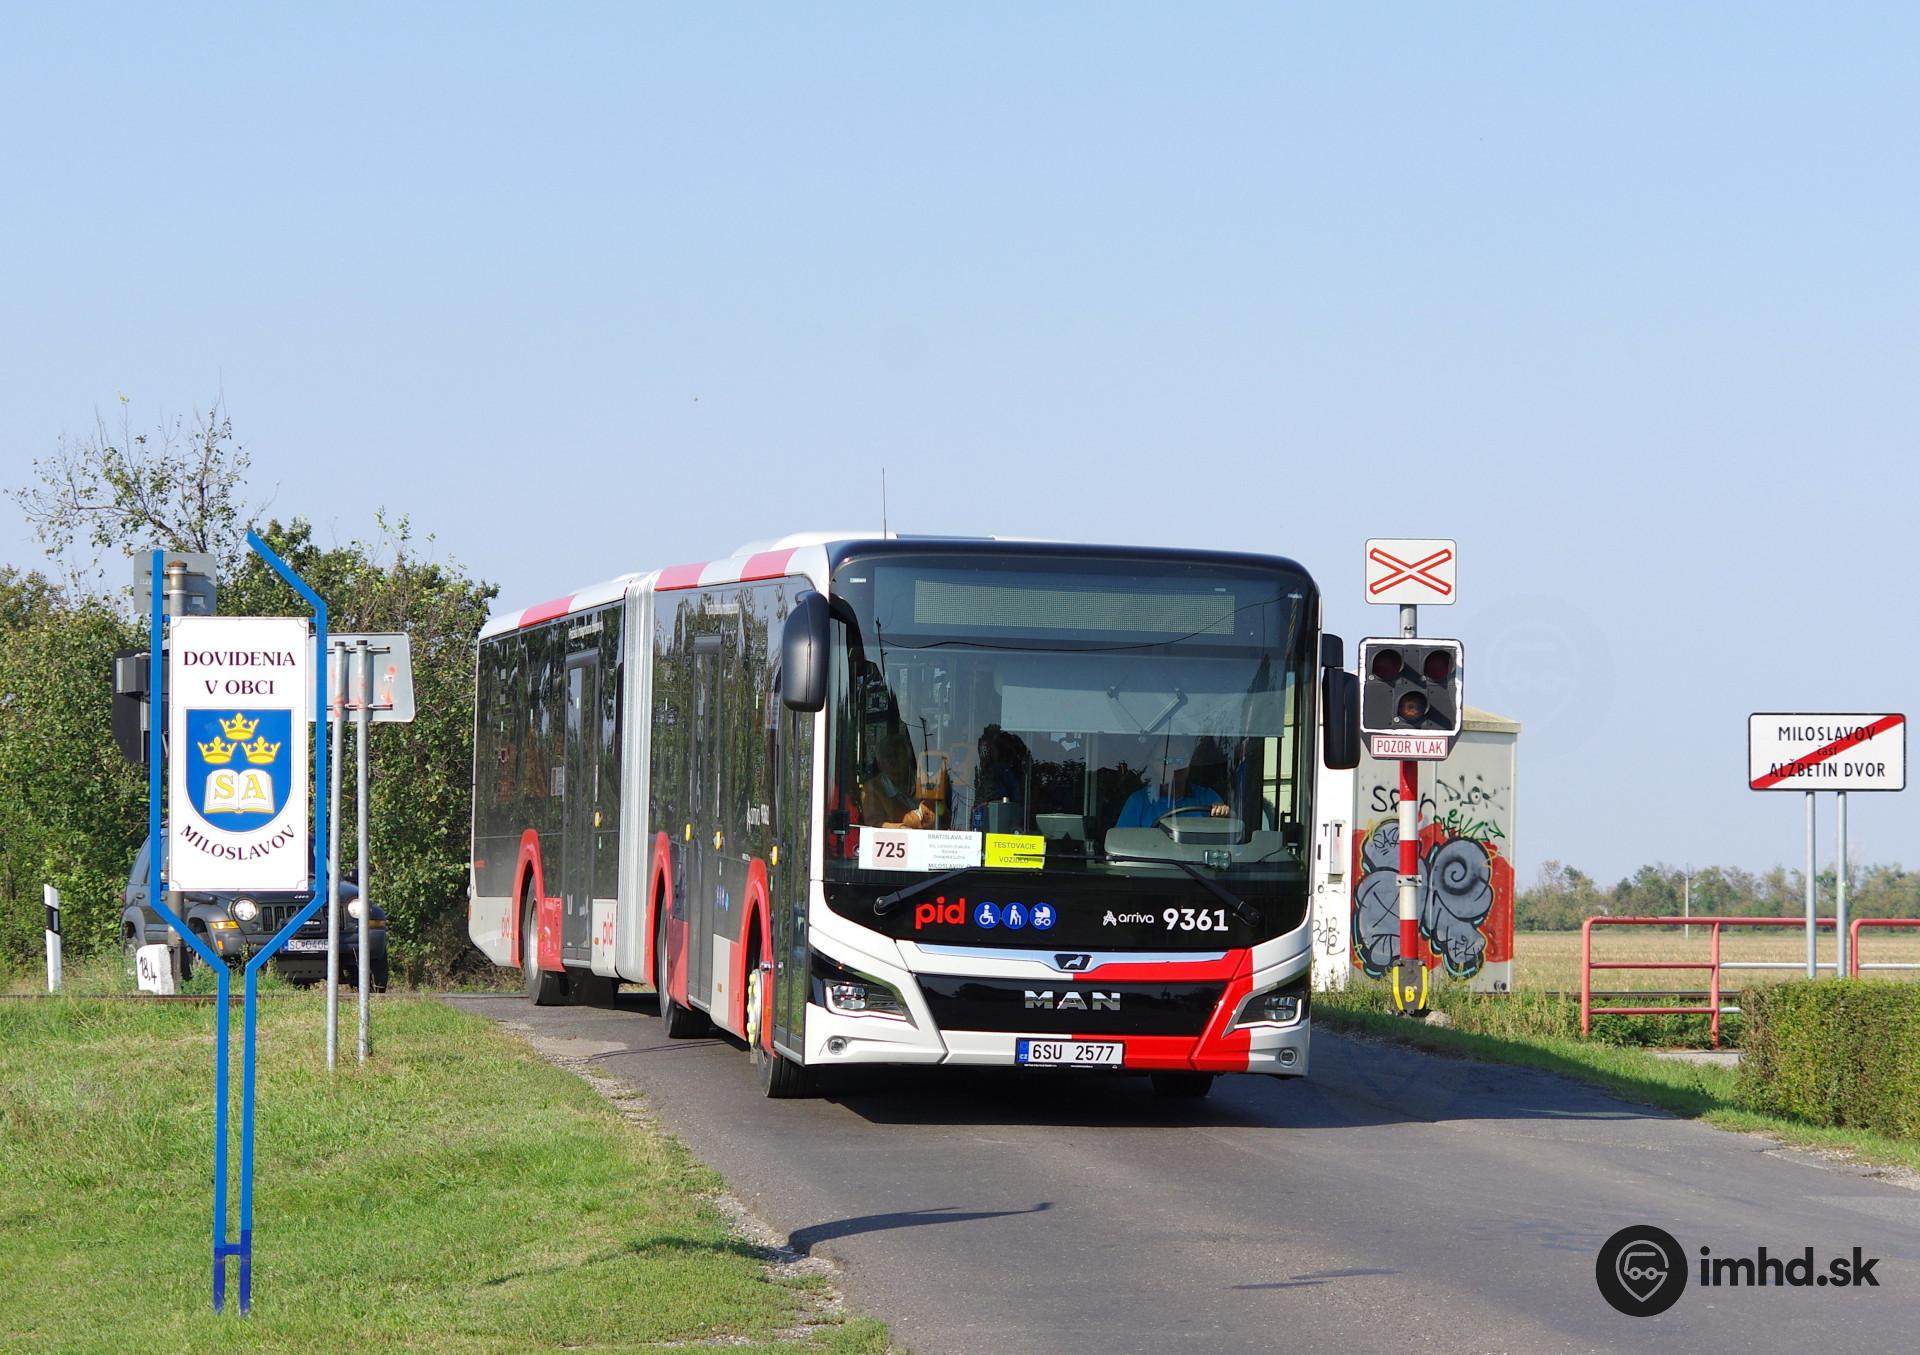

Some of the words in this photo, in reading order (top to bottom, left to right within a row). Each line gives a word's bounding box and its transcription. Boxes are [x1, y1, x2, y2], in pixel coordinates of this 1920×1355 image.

[183, 651, 296, 666] DOVIDENIA
[205, 680, 218, 695] V
[225, 680, 274, 695] OBCI
[1778, 726, 1876, 741] MILOSLAVOV
[1377, 740, 1411, 753] POZOR
[1416, 740, 1443, 754] VLAK
[1769, 758, 1838, 777] ALŽBETIN
[1844, 762, 1886, 777] DVOR
[180, 824, 295, 861] MILOSLAVOV
[875, 841, 906, 858] 725
[914, 896, 966, 930] pid
[1118, 911, 1155, 924] arriva
[1162, 907, 1229, 932] 9361
[139, 956, 157, 984] 18,4
[1024, 990, 1121, 1011] MAN
[1032, 1043, 1063, 1060] 6SU
[1075, 1045, 1115, 1061] 2577
